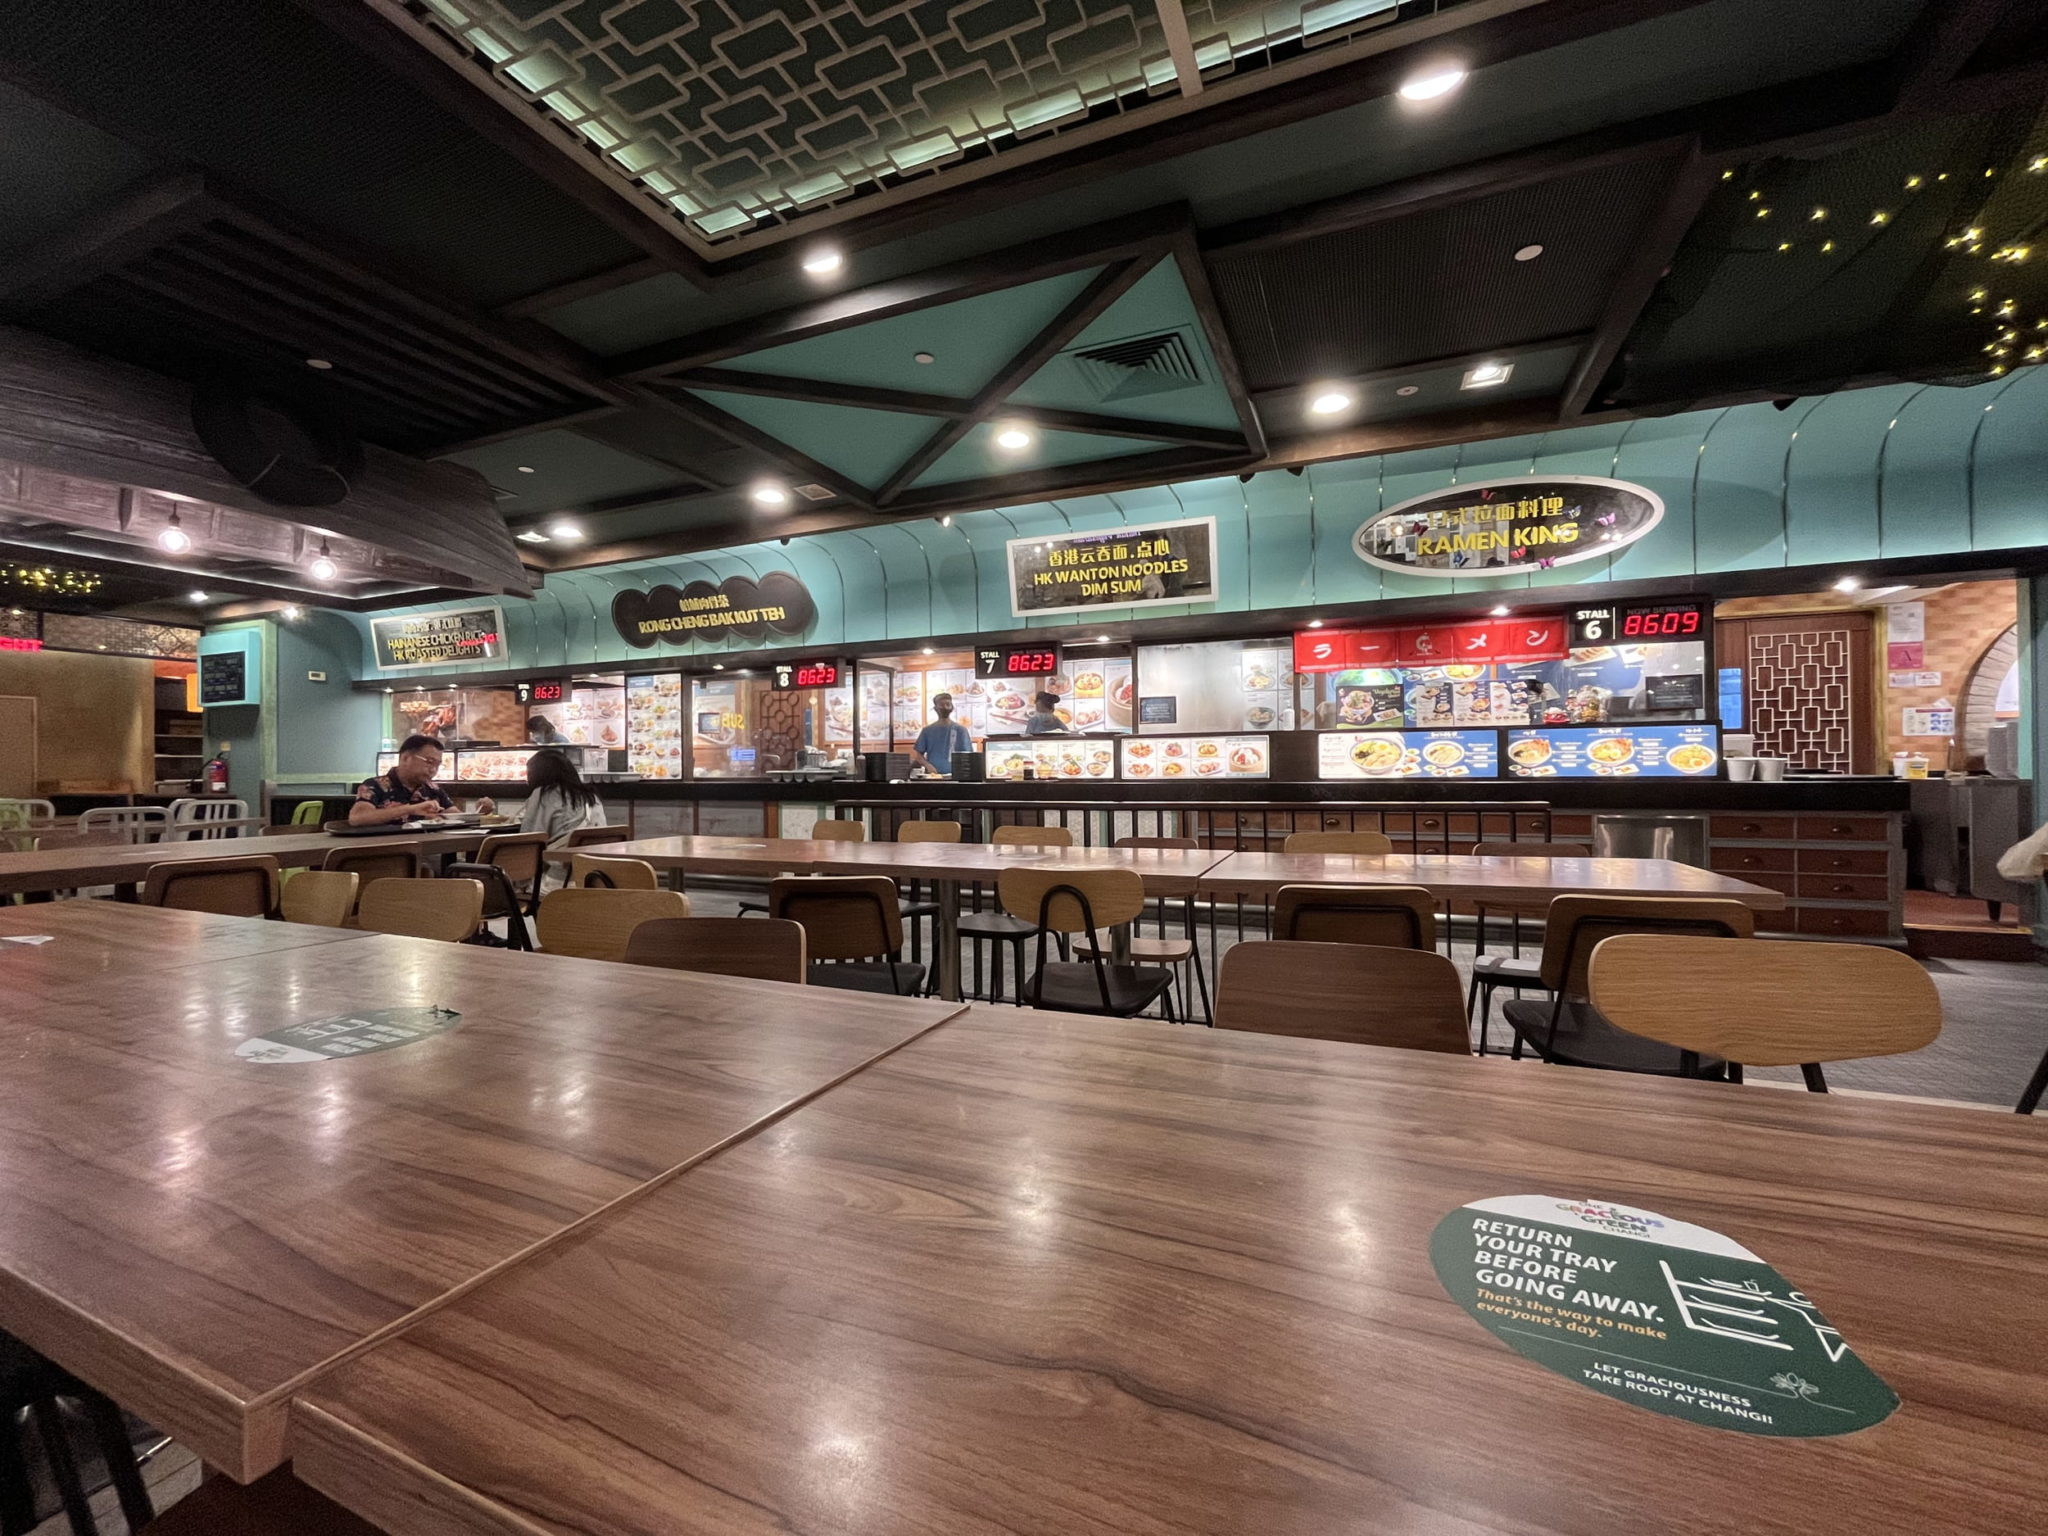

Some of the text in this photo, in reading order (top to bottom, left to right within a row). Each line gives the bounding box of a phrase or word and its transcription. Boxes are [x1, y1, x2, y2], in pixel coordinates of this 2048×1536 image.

[1417, 522, 1579, 555] RAMEN KING
[1034, 559, 1189, 585] HK WANTON NOODLES
[1081, 579, 1142, 596] DIM SUM
[638, 607, 786, 633] RONG CHENG BAK KUT TEH
[1576, 609, 1610, 620] STALL
[1624, 612, 1699, 635] 8609
[1585, 620, 1602, 639] 6
[388, 635, 431, 650] HAINANESE
[430, 632, 465, 646] CHICKEN
[405, 646, 440, 660] ROASTED
[443, 645, 481, 657] DELIGHTS
[980, 651, 1000, 659] STALL
[985, 659, 995, 674] 7
[1008, 654, 1054, 672] 8623
[780, 673, 789, 687] 8
[798, 667, 836, 685] 8623
[521, 689, 528, 701] 9
[534, 686, 561, 699] 8623
[1472, 1218, 1573, 1248] RETURN
[1474, 1233, 1618, 1273] YOUR TRAY
[1474, 1250, 1578, 1284] BEFORE
[1475, 1269, 1665, 1323] GOING AWAY.
[1526, 1300, 1553, 1314] the
[1557, 1307, 1592, 1324] way
[1594, 1315, 1613, 1328] to
[1617, 1321, 1667, 1340] make
[1566, 1320, 1603, 1338] day.
[1594, 1362, 1752, 1407] LET GRACIOUSNESS
[1583, 1369, 1774, 1425] TAKE ROOT AT CHANGI!
